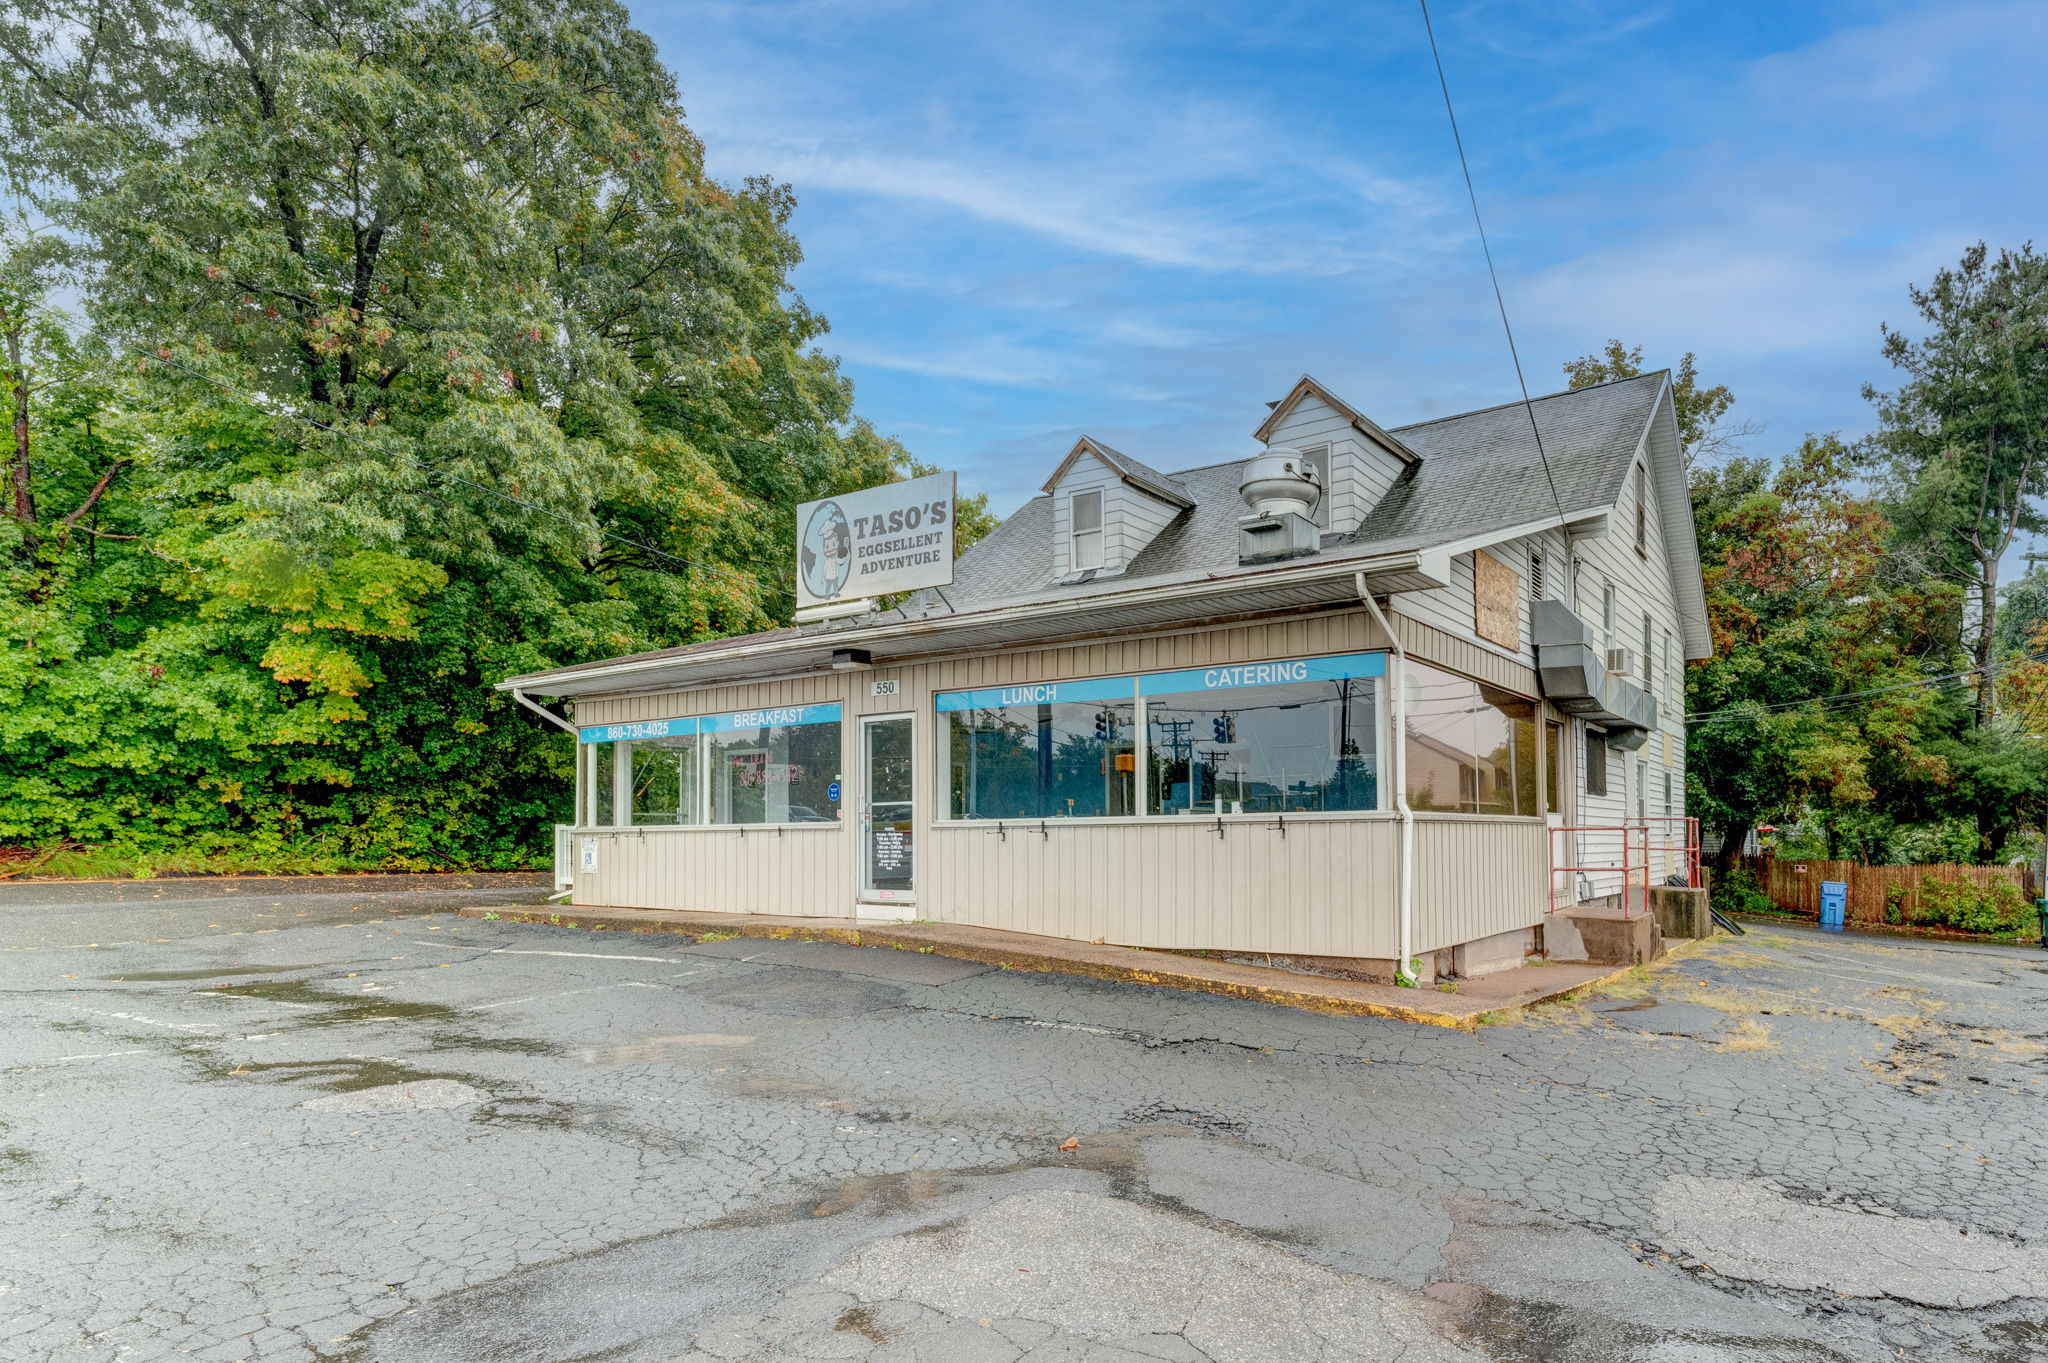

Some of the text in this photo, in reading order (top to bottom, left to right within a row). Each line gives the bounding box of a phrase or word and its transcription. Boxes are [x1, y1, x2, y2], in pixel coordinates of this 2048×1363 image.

[853, 500, 947, 540] TASO'S
[858, 531, 943, 559] EGGSELLENT
[860, 549, 941, 575] ADVENTURE
[1204, 661, 1307, 688] CATERING
[876, 681, 895, 695] 550
[1001, 684, 1057, 705] LUNCH
[734, 708, 804, 728] BREAKFAST
[607, 722, 669, 740] 860-730-4025
